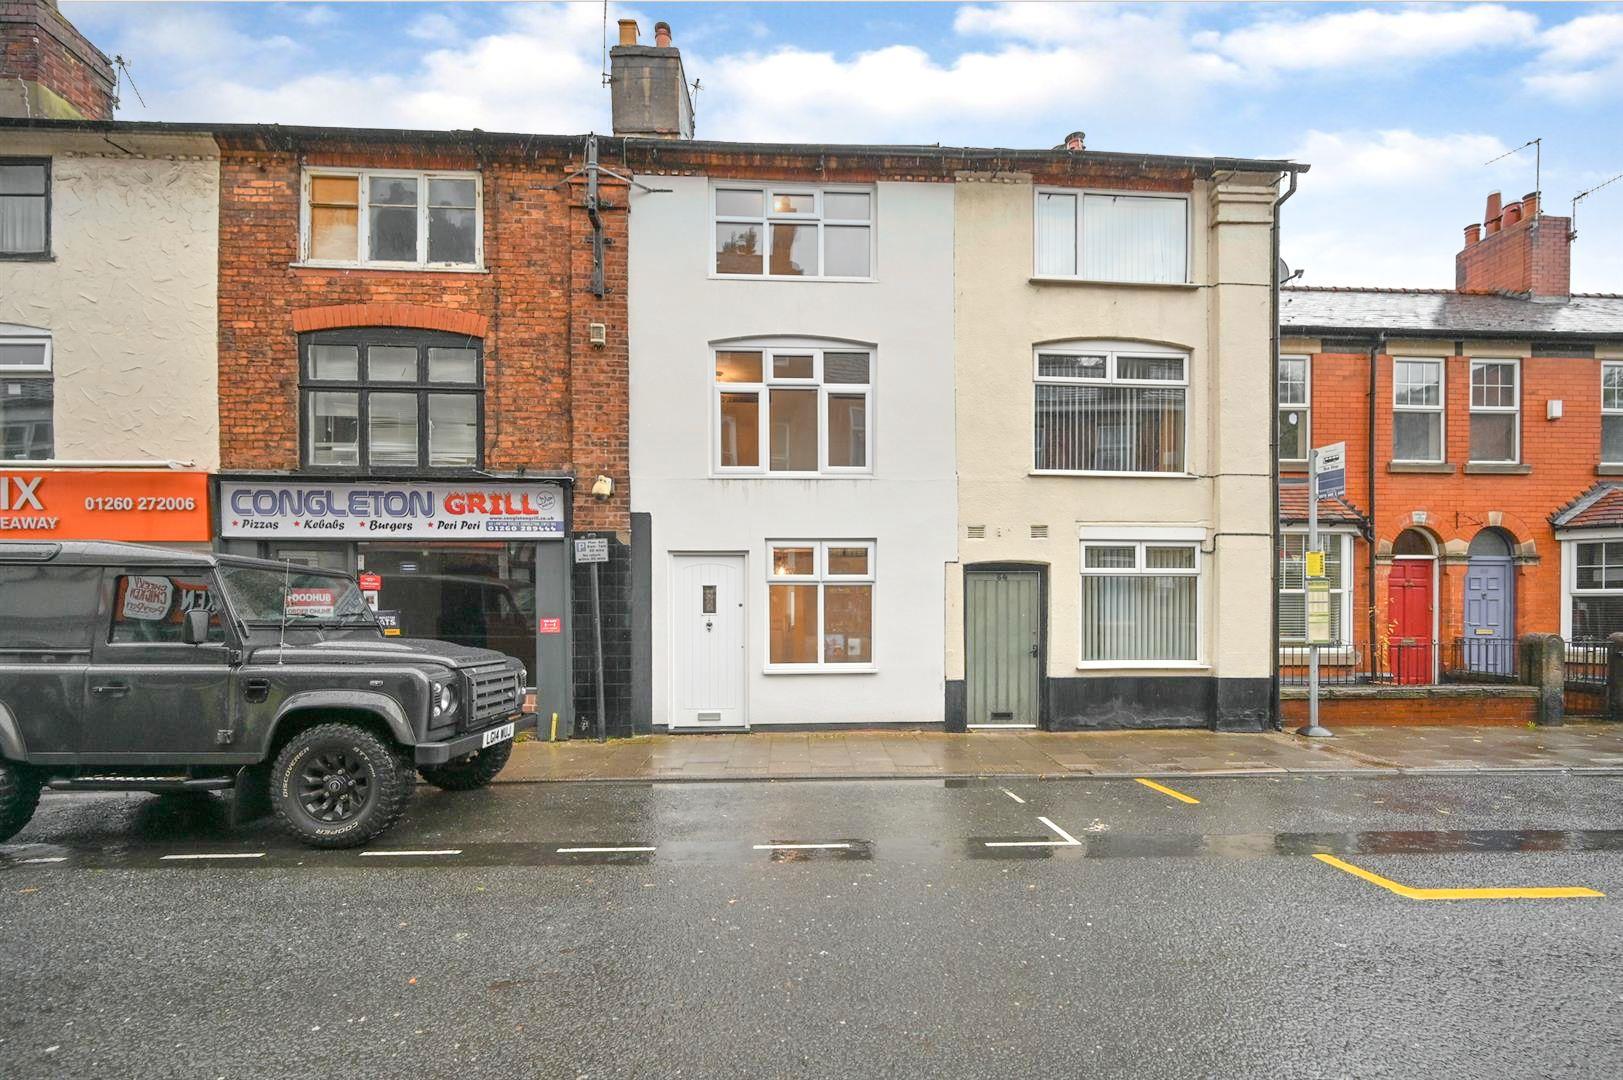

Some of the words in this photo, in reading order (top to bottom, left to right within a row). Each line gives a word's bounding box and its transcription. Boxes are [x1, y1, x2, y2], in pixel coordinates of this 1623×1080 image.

[84, 496, 133, 511] 01260
[138, 496, 196, 511] 272006
[230, 489, 435, 518] CONGLETON
[443, 490, 539, 516] GRILL
[0, 516, 58, 530] EAWAY
[241, 519, 279, 530] Pizzas
[303, 519, 345, 531] Kebabs
[369, 520, 413, 532] Burgers
[437, 520, 457, 531] Peri
[460, 520, 481, 531] Peri
[315, 821, 360, 835] COOPER
